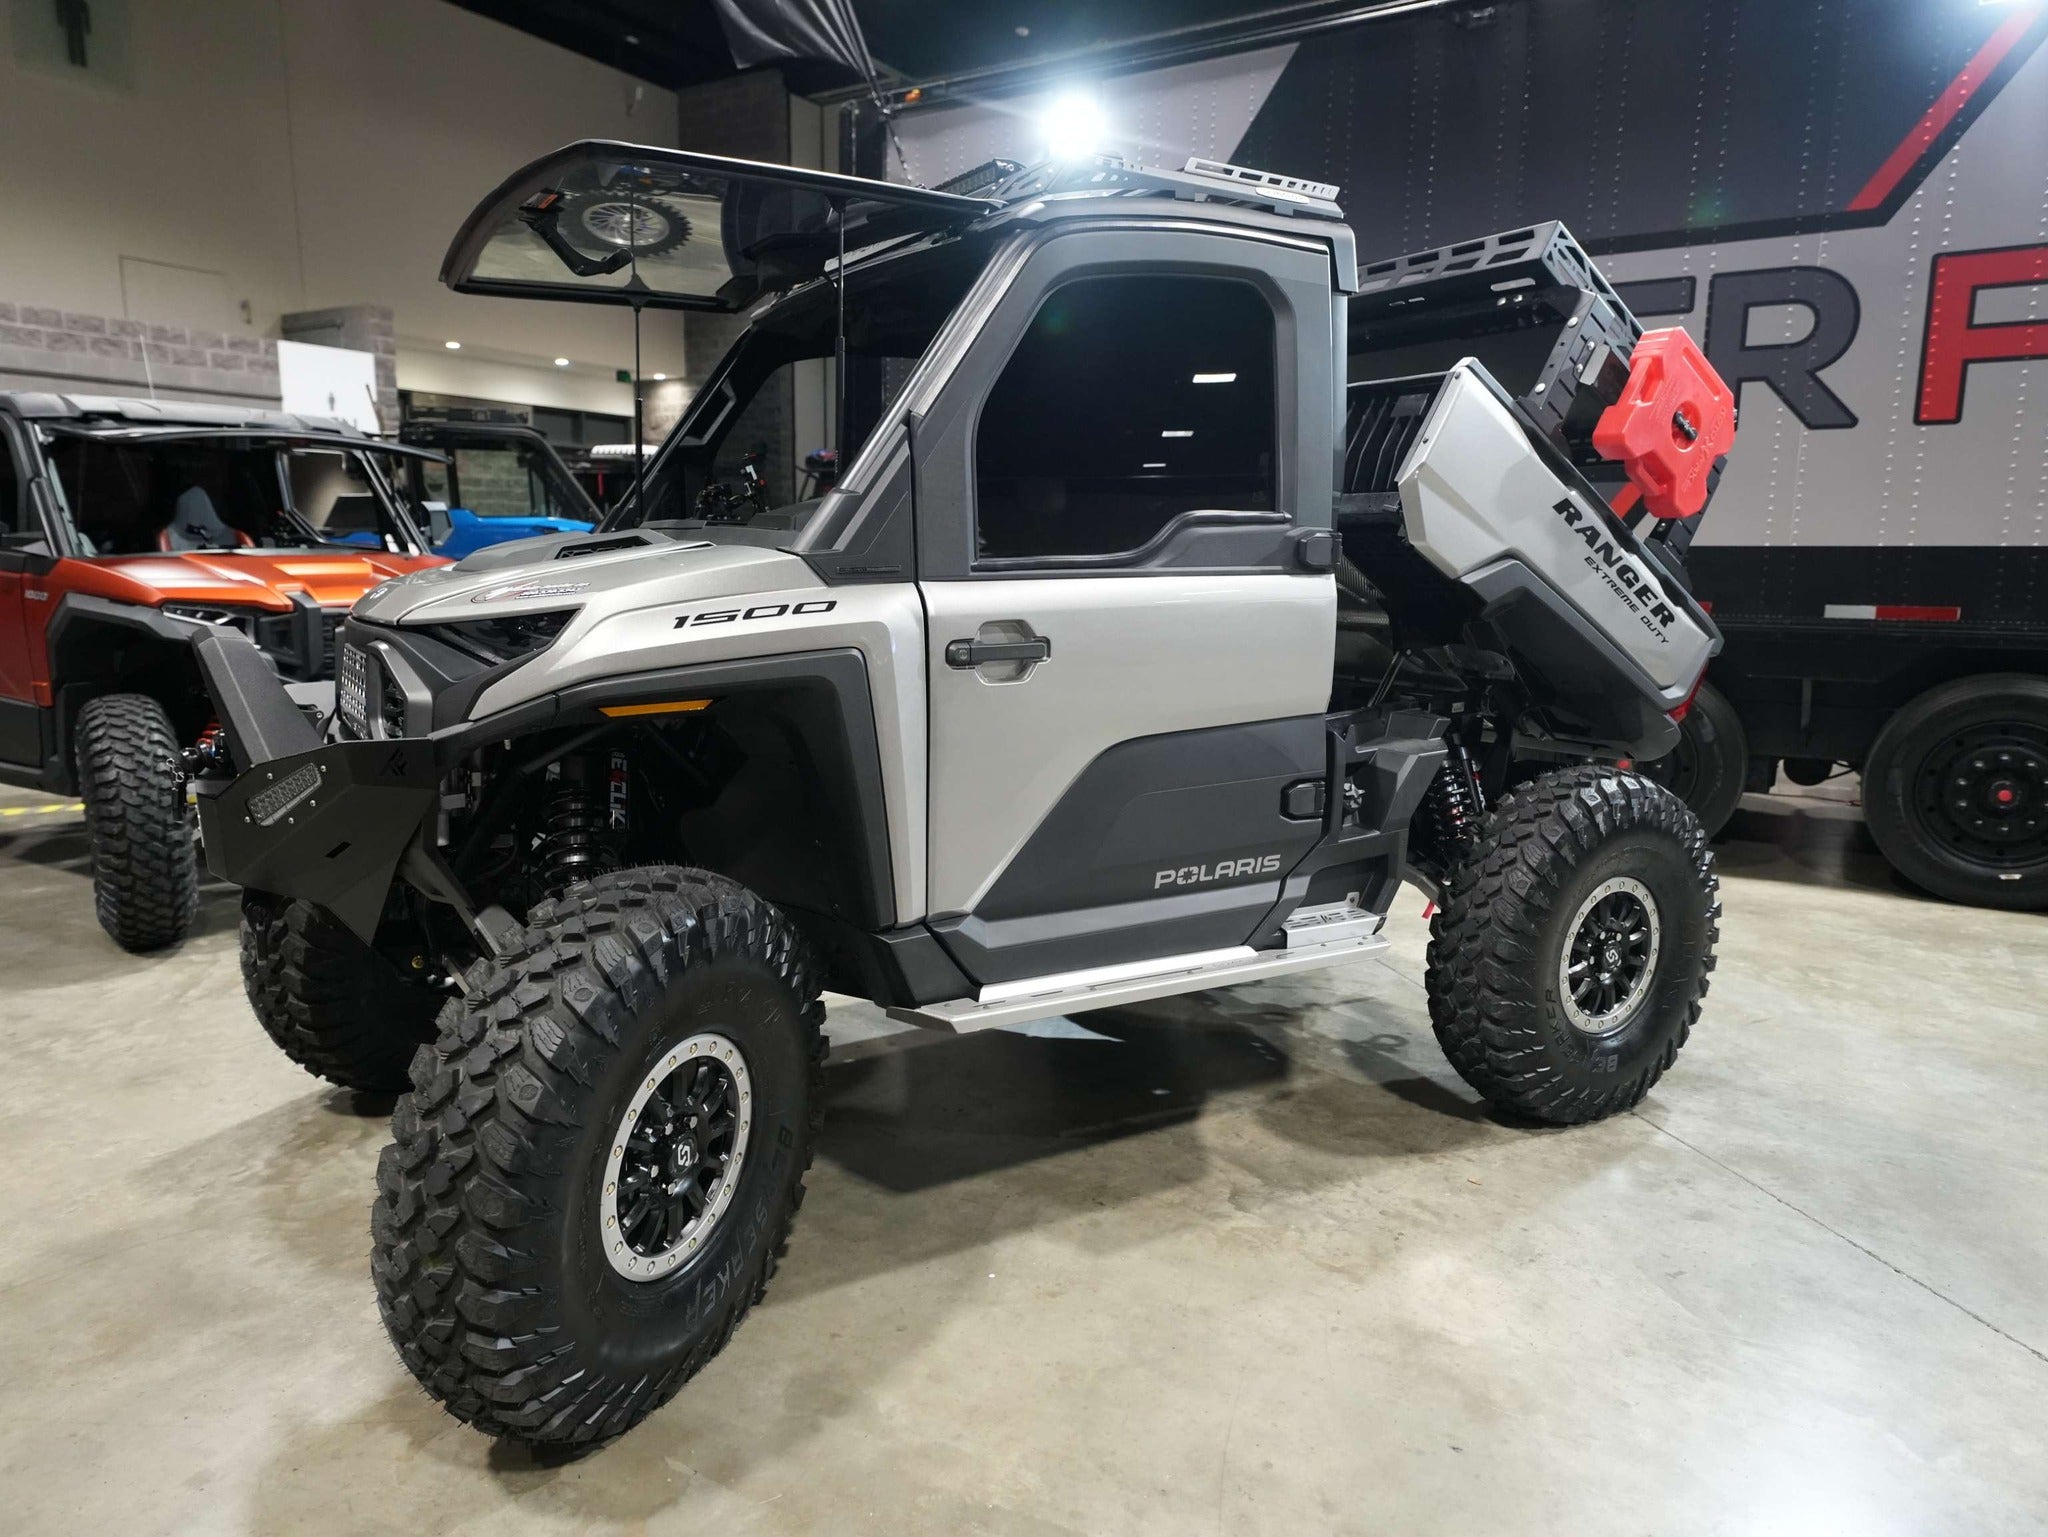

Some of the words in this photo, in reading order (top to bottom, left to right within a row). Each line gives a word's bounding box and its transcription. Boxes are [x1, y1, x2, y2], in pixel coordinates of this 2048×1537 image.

[1552, 497, 1675, 629] RANGER
[673, 600, 838, 630] 1500
[1584, 556, 1640, 614] EXTREME
[1640, 615, 1669, 644] DUTY
[1154, 853, 1281, 890] POLARIS
